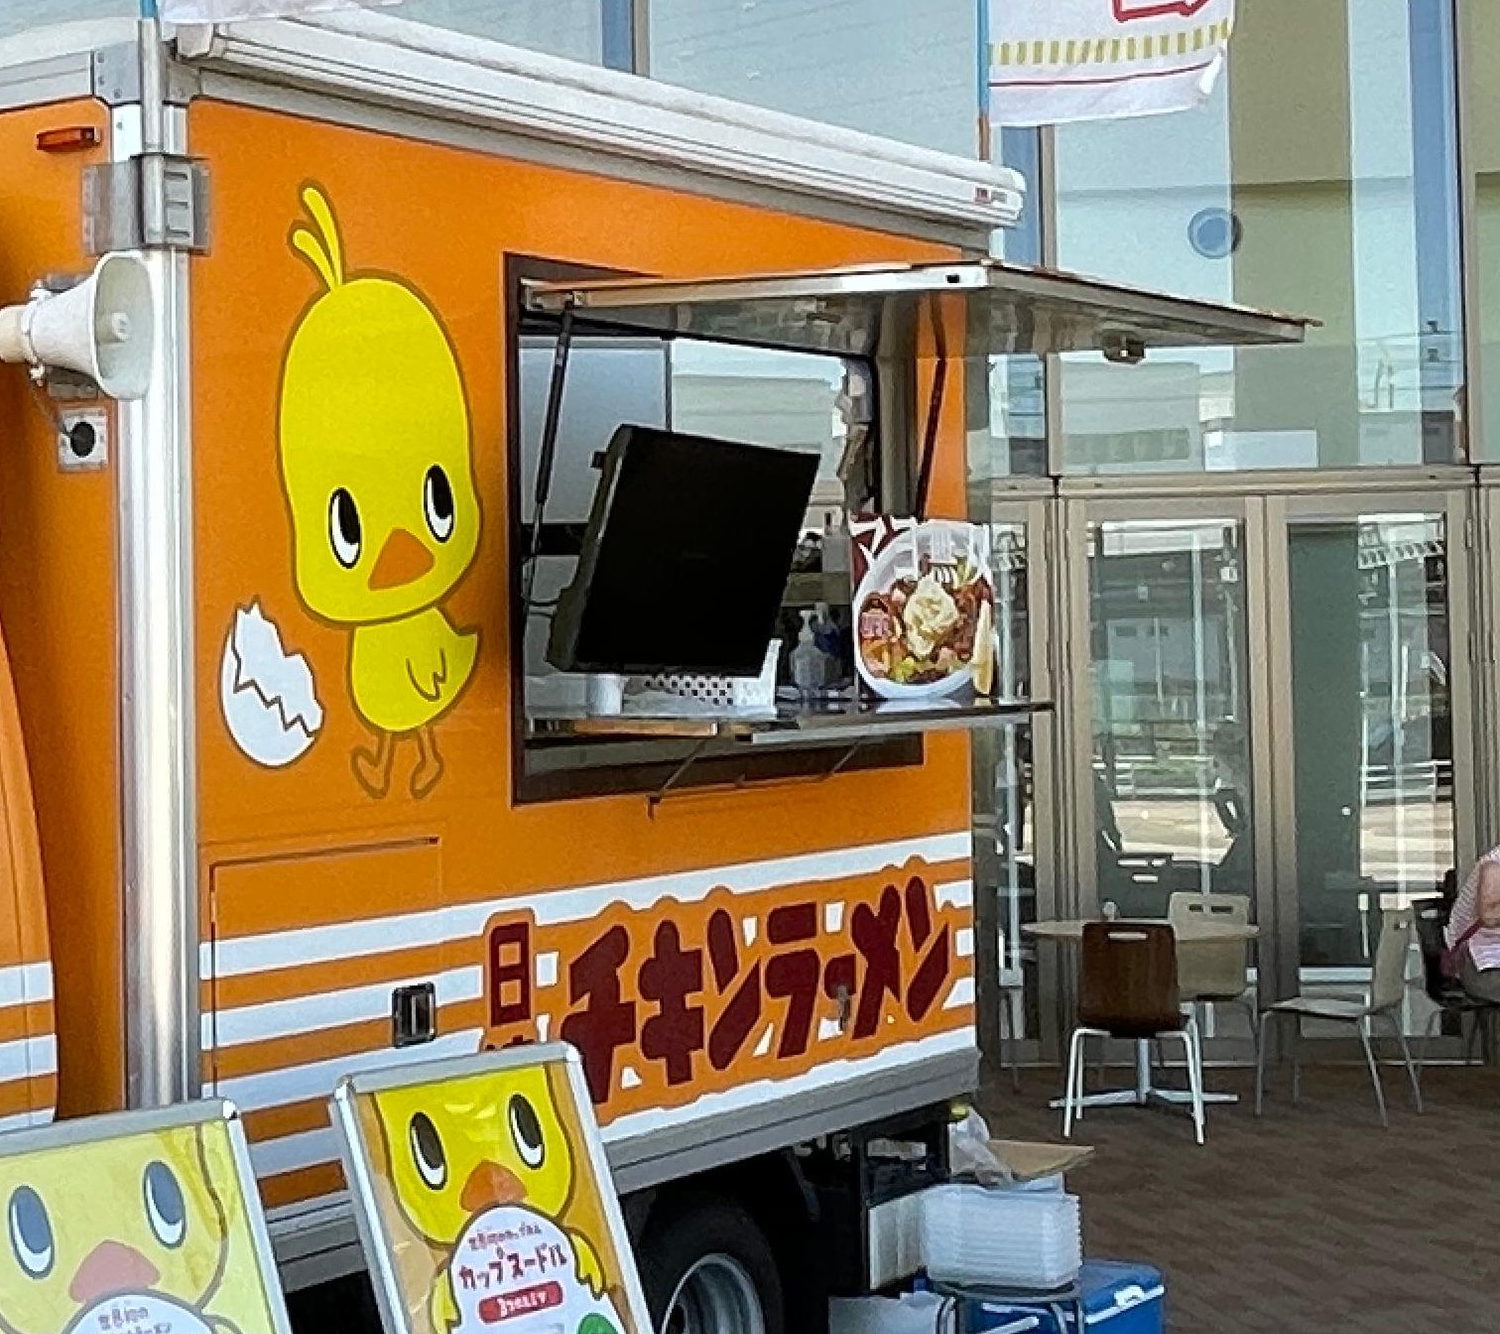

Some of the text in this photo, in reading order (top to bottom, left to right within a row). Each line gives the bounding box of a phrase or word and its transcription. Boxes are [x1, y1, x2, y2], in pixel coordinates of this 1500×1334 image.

[484, 917, 534, 1053] 日
[558, 873, 952, 1105] チキンラーメン
[458, 1243, 568, 1291] カップヌードル
